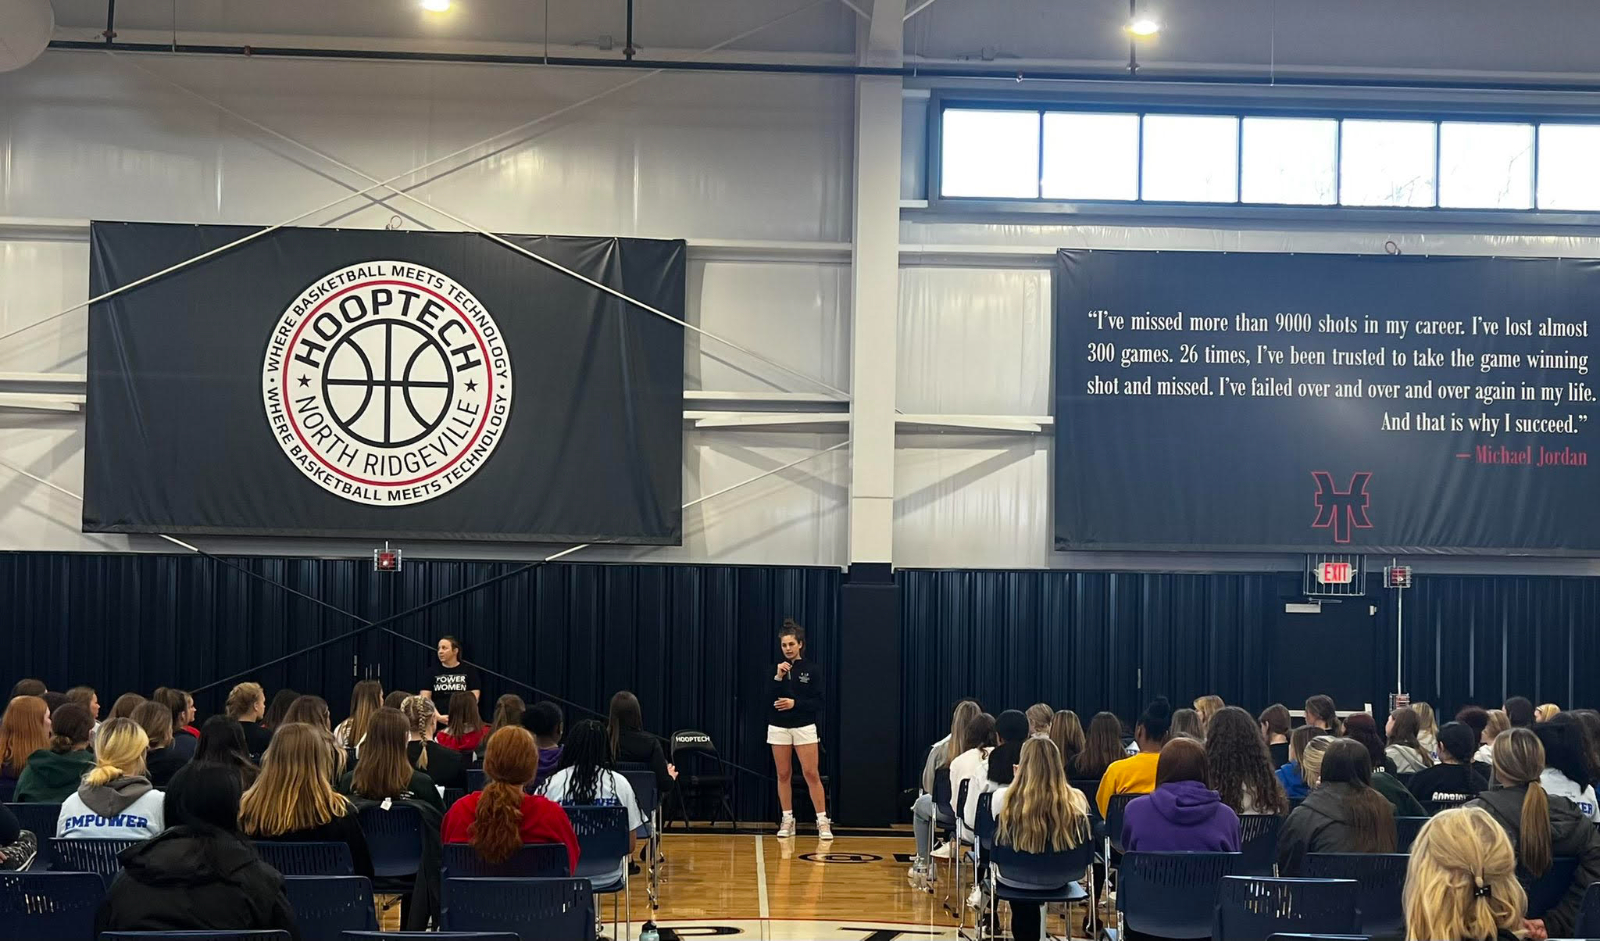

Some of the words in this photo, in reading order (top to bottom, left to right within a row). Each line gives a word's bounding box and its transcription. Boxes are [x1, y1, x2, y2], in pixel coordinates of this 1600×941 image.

[266, 316, 297, 372] WHERE
[292, 265, 387, 317] BASKETBALL
[391, 265, 446, 289] MEETS
[449, 284, 508, 379] TECHNOLOGY
[294, 288, 482, 373] HOOPTECH
[1131, 311, 1183, 331] missed
[1189, 317, 1229, 332] more
[1235, 312, 1269, 332] than
[1275, 312, 1312, 333] 9000
[1318, 313, 1358, 334] shots
[1364, 314, 1379, 334] in
[1385, 320, 1409, 340] my
[1415, 320, 1465, 335] career.
[1505, 316, 1533, 336] lost
[1538, 317, 1589, 338] almost
[1087, 342, 1115, 363] 300
[1120, 348, 1174, 368] games.
[1179, 343, 1199, 364] 26
[1205, 344, 1251, 367] times,
[1290, 345, 1326, 365] been
[1332, 347, 1385, 366] trusted
[1392, 349, 1407, 367] to
[1413, 347, 1445, 367] take
[1450, 348, 1475, 368] the
[1480, 353, 1521, 373] game
[1526, 349, 1589, 375] winning
[1087, 375, 1120, 395] shot
[1123, 375, 1152, 395] and
[1157, 376, 1214, 396] missed.
[1251, 377, 1293, 397] failed
[1297, 383, 1331, 398] over
[1334, 379, 1362, 398] and
[1367, 384, 1401, 399] over
[1404, 379, 1433, 399] and
[1437, 385, 1471, 400] over
[1475, 381, 1516, 405] again
[1521, 381, 1535, 401] in
[1540, 386, 1564, 407] my
[1568, 382, 1597, 402] life.
[295, 395, 359, 468] NORTH
[363, 399, 480, 477] RIDGEVILLE
[1381, 411, 1410, 431] And
[1416, 412, 1446, 432] that
[1451, 412, 1464, 432] is
[1468, 412, 1501, 438] why
[266, 386, 295, 445] WHERE
[290, 445, 382, 501] BASKETBALL
[387, 483, 442, 501] MEETS
[442, 394, 508, 484] TECHNOLOGY
[1475, 445, 1532, 465] Michael
[1537, 446, 1588, 466] Jordan
[1324, 564, 1348, 582] EXIT
[433, 683, 467, 692] WOMEN
[65, 814, 148, 830] EMPOWER
